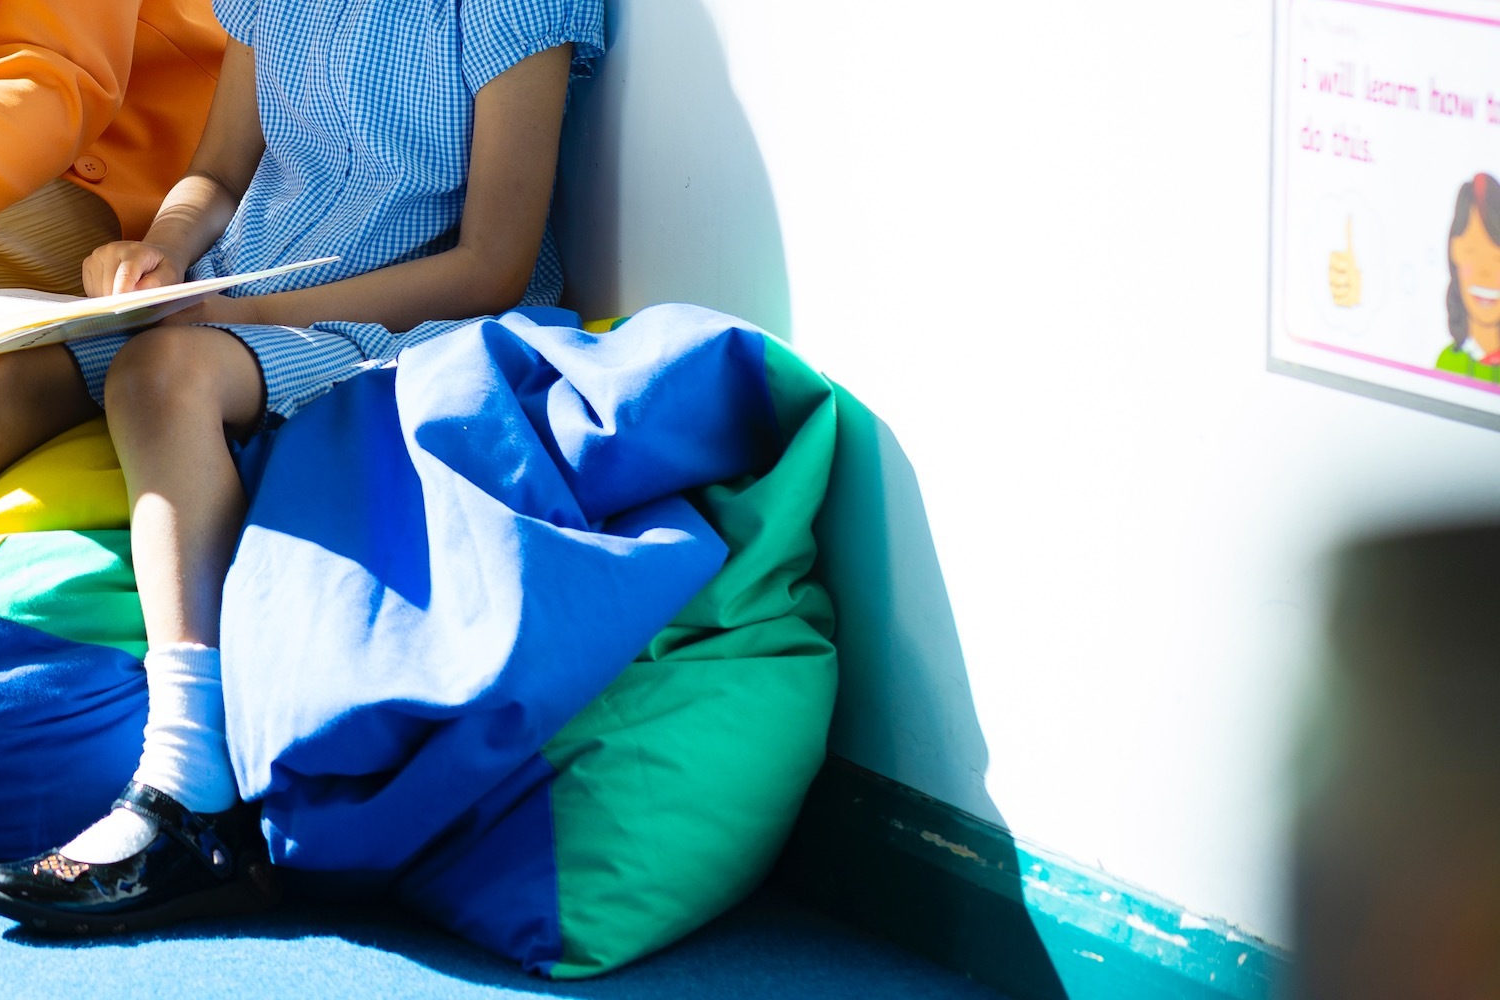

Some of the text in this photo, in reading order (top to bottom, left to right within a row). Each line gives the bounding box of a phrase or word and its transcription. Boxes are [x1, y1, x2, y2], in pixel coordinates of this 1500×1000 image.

[1301, 56, 1308, 92] I
[1318, 62, 1356, 99] will
[1365, 66, 1421, 113] learn
[1428, 76, 1477, 120] how
[1300, 116, 1324, 154] do
